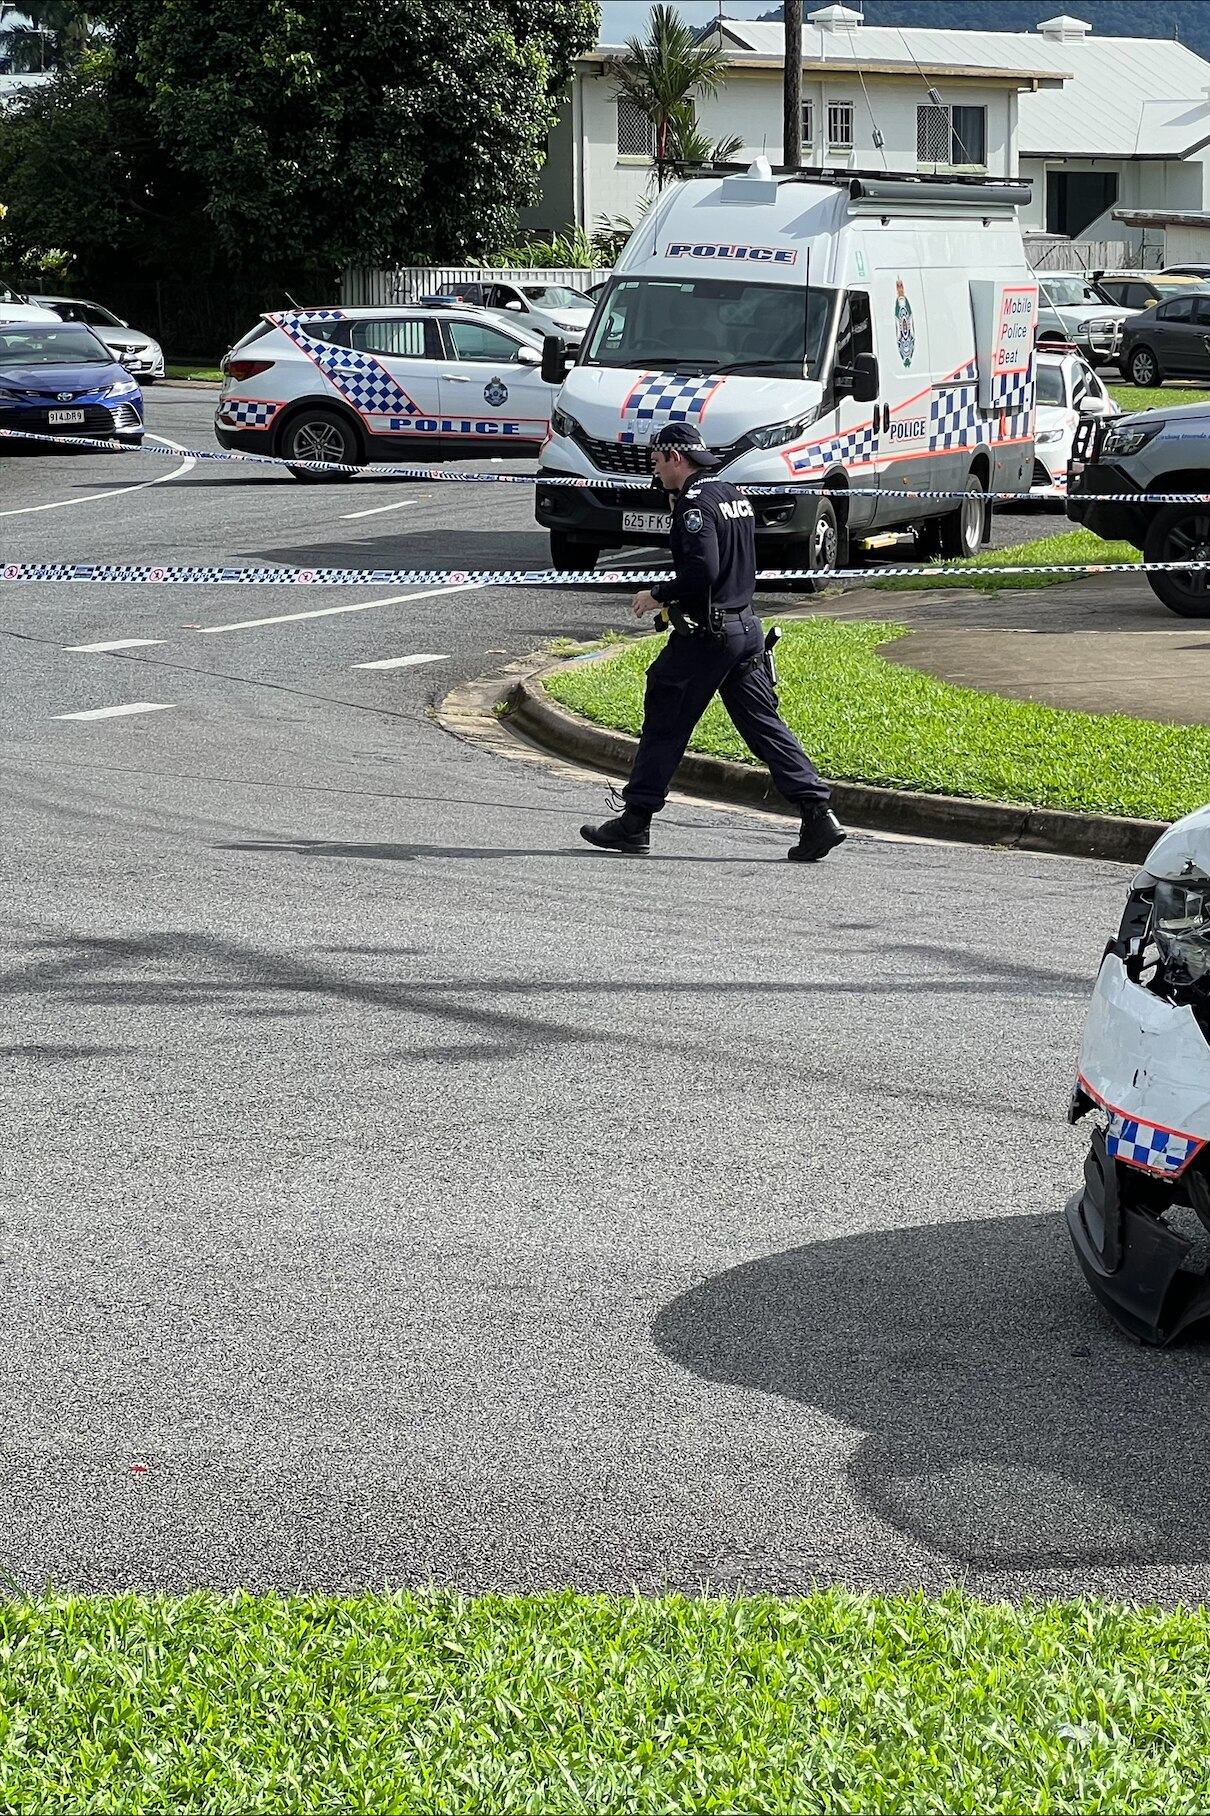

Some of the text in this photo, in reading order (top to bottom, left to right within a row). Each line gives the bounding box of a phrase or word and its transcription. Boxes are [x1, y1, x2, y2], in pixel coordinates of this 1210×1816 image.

[668, 244, 795, 264] POLICE
[1004, 298, 1032, 315] Mobile
[1001, 323, 1027, 341] Police
[997, 348, 1018, 365] Beat
[390, 418, 520, 435] POLICE
[890, 420, 926, 440] POLICE
[719, 499, 755, 521] POLICE
